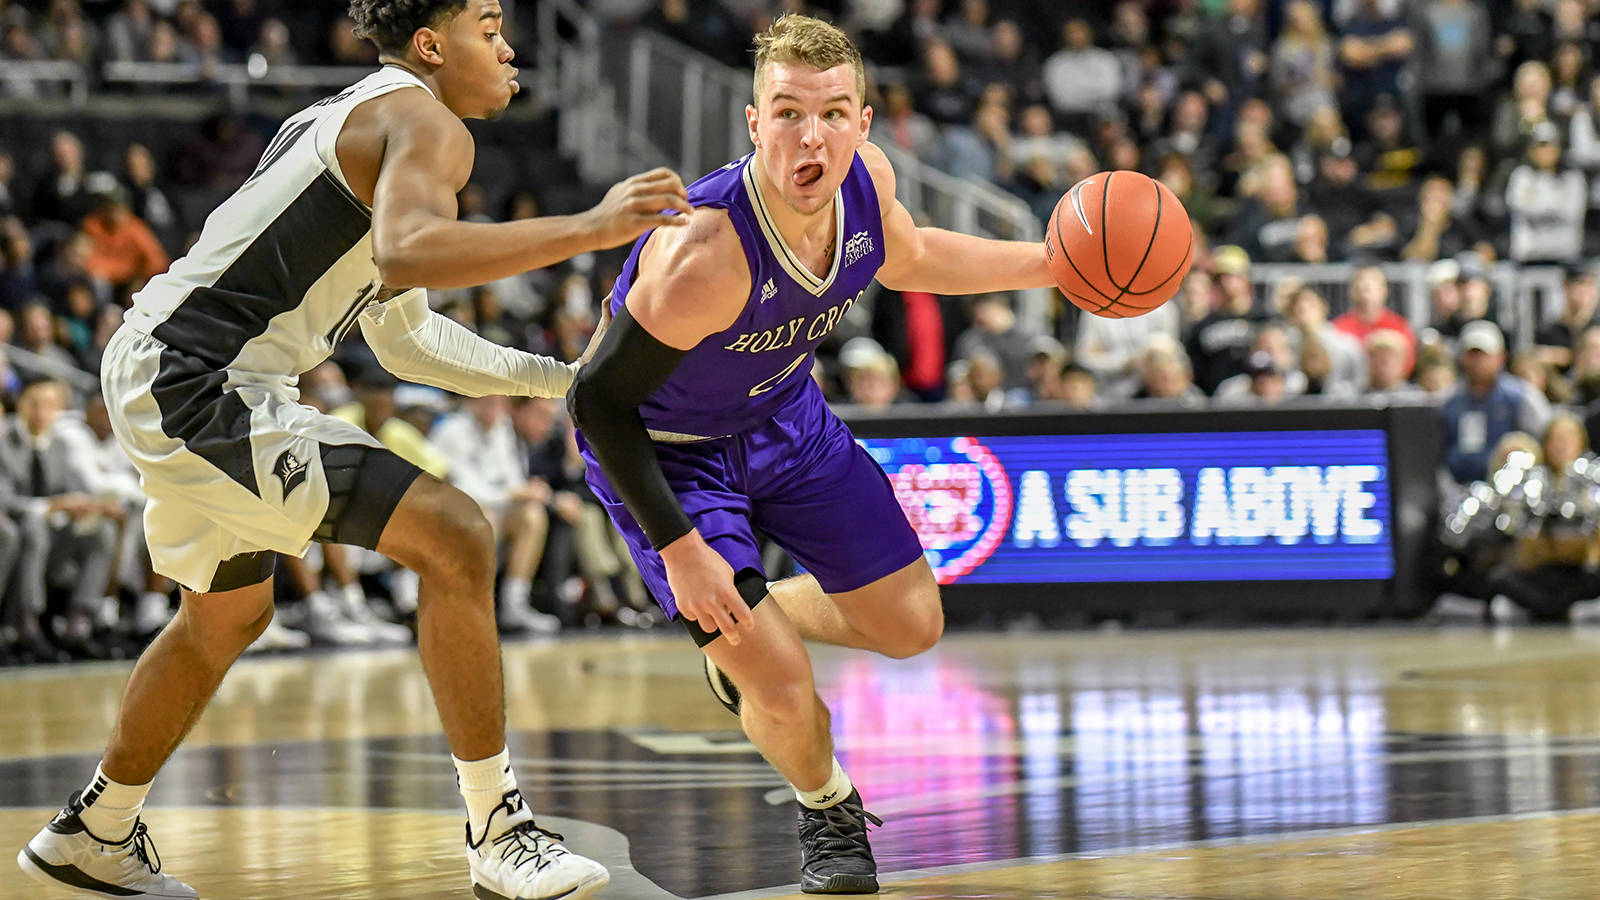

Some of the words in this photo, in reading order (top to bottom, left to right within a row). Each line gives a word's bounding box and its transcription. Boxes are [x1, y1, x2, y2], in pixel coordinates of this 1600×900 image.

[724, 317, 805, 353] HOLY
[807, 290, 863, 341] CRO
[1014, 470, 1061, 547] A
[1065, 468, 1184, 547] SUB
[1191, 465, 1383, 545] ABOVE
